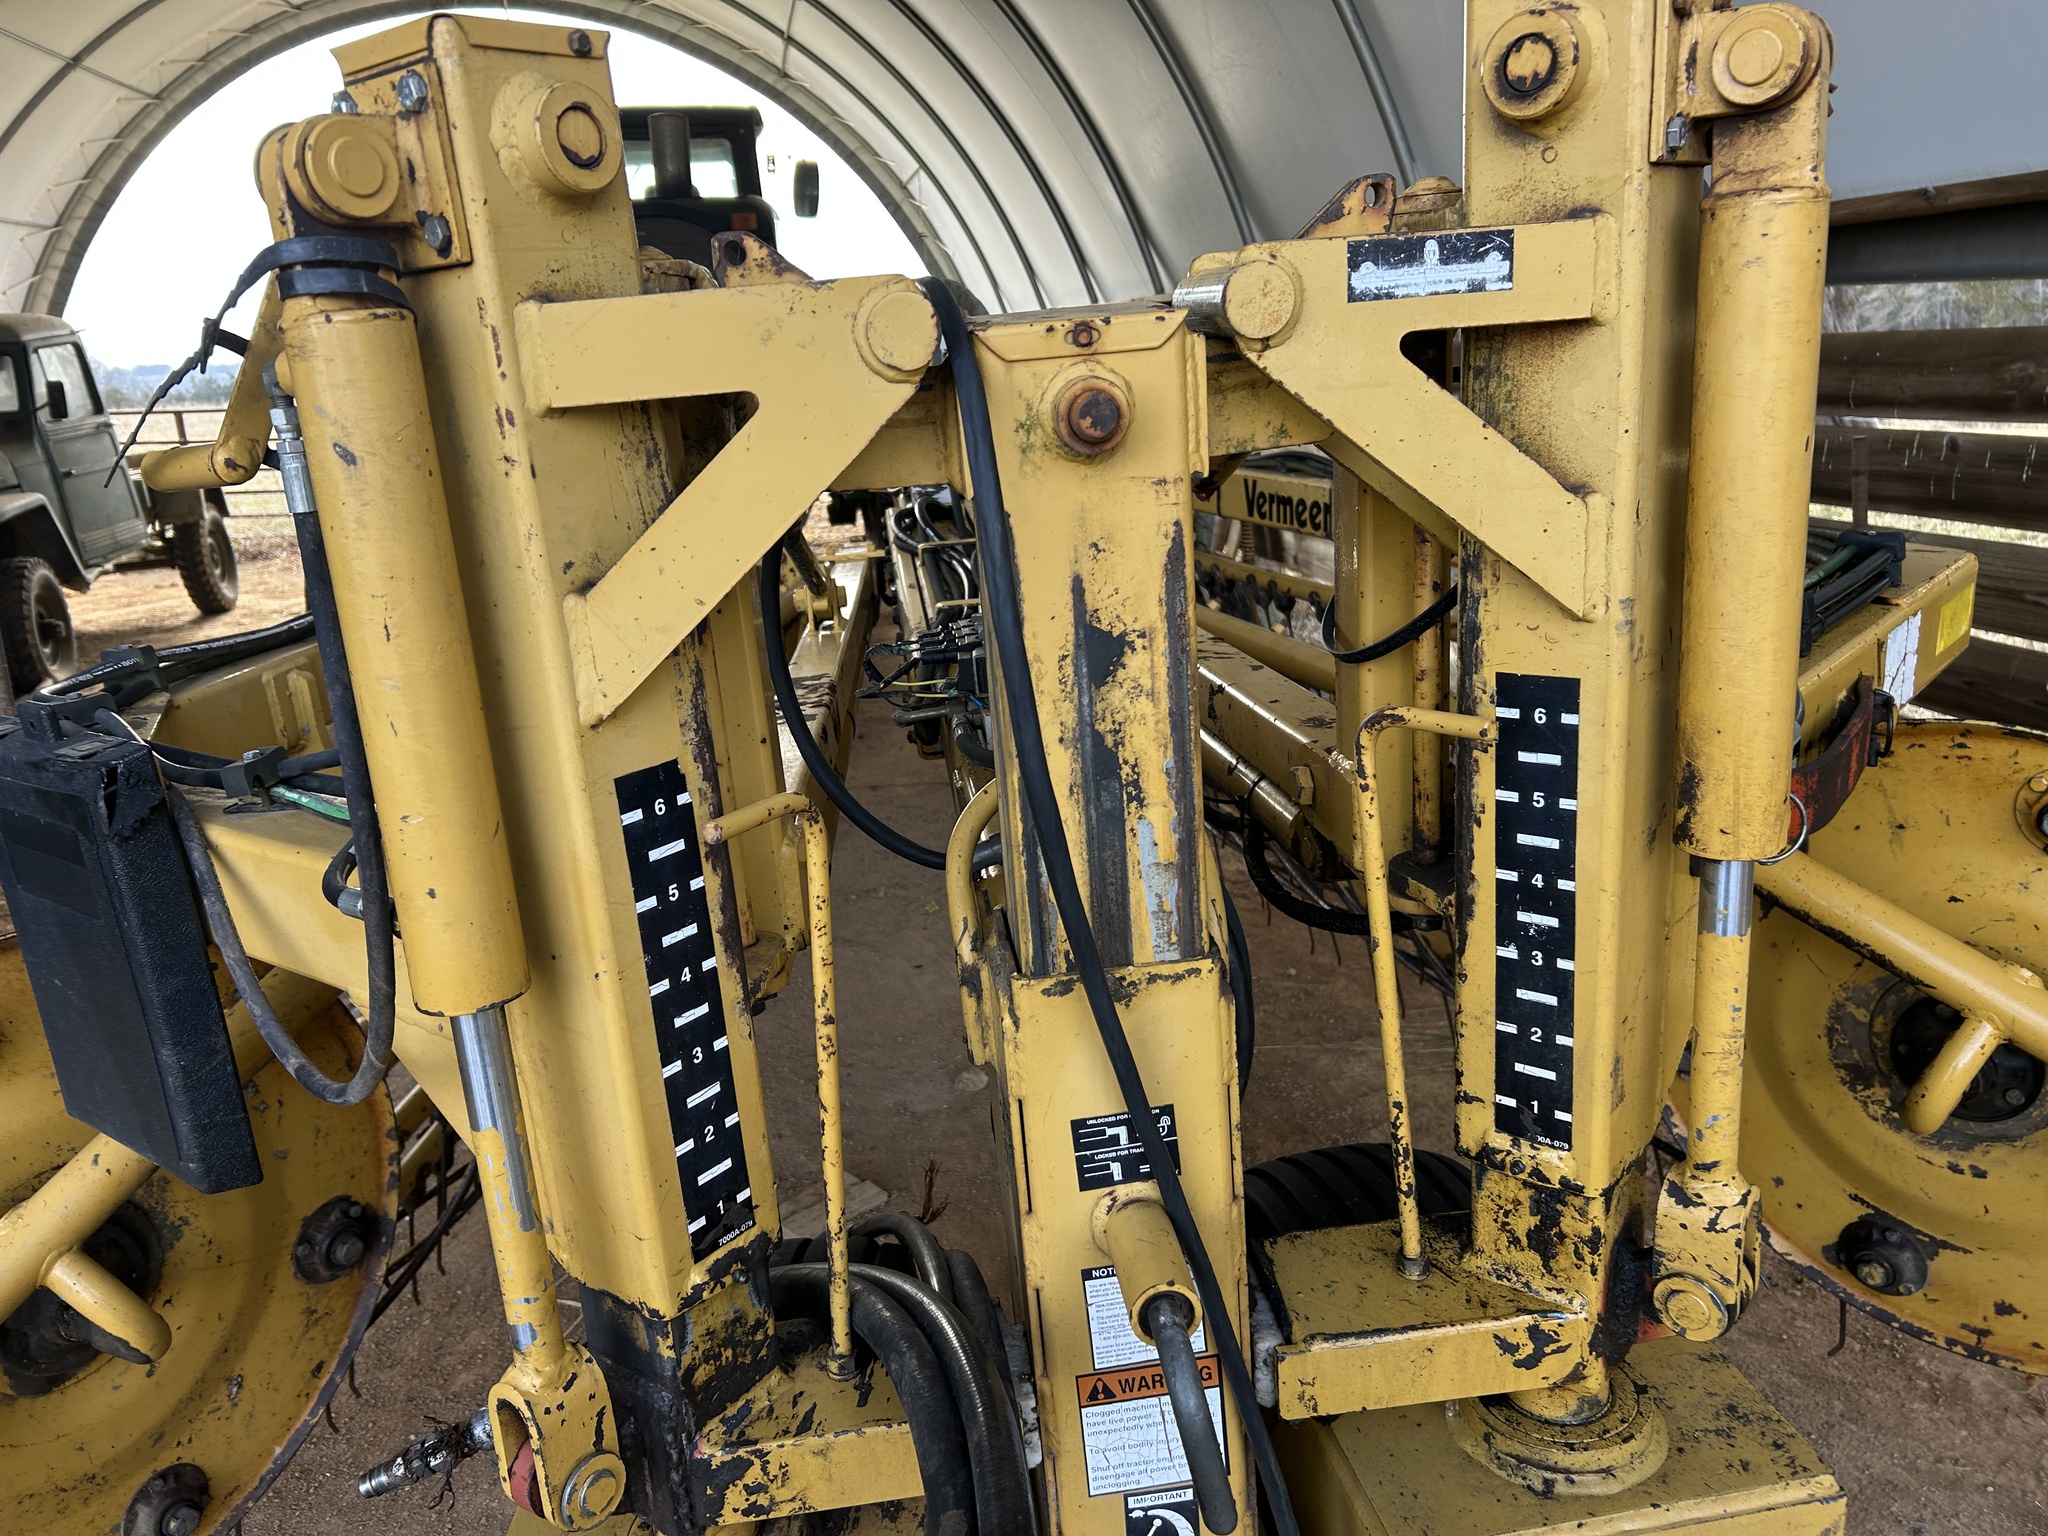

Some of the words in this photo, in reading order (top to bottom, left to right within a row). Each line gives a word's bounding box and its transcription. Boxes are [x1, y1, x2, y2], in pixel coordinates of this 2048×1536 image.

[1533, 707, 1547, 725] 6
[654, 798, 666, 816] 6
[1532, 791, 1546, 808] 5
[1531, 873, 1545, 889] 4
[668, 883, 679, 902] 5
[1530, 950, 1543, 966] 3
[680, 966, 692, 983] 4
[1530, 1026, 1543, 1043] 2
[692, 1046, 703, 1064] 3
[1530, 1099, 1539, 1114] 1
[1086, 1116, 1116, 1125] UNLOCKED
[704, 1124, 715, 1143] 2
[1536, 1135, 1569, 1150] 00A-079
[1094, 1152, 1117, 1160] LOCKED
[716, 1199, 725, 1215] 1
[718, 1219, 753, 1246] 7000A-079
[1117, 1365, 1213, 1394] WARG
[1085, 1408, 1120, 1418] Clogged
[1123, 1402, 1159, 1413] machine
[1086, 1420, 1106, 1428] have
[1108, 1417, 1124, 1425] live
[1087, 1423, 1144, 1437] unexpectedly
[1145, 1419, 1169, 1428] when
[1102, 1444, 1125, 1453] avoid
[1128, 1440, 1153, 1450] bodily
[1091, 1465, 1110, 1473] Shut
[1113, 1462, 1125, 1470] off
[1127, 1458, 1154, 1468] tractor
[1157, 1454, 1185, 1464] engine
[1092, 1471, 1135, 1482] disengage
[1150, 1464, 1176, 1475] power
[1093, 1479, 1142, 1491] unclogging.
[1133, 1491, 1188, 1505] IMPORTANT
